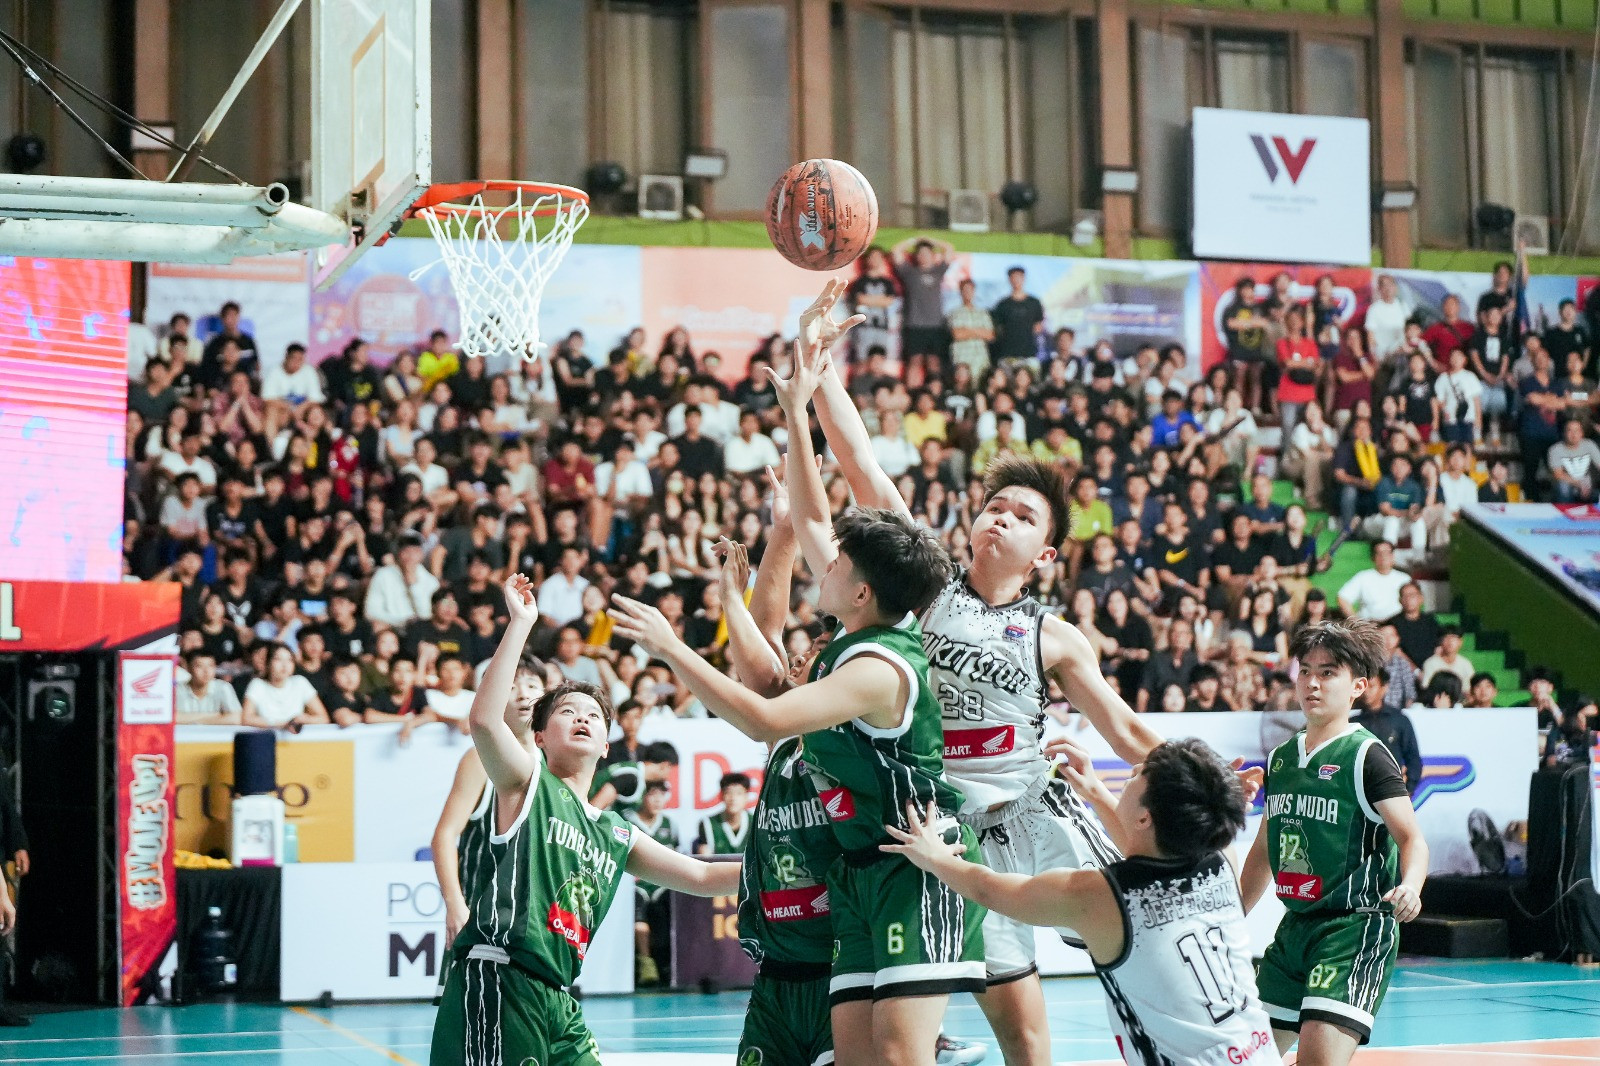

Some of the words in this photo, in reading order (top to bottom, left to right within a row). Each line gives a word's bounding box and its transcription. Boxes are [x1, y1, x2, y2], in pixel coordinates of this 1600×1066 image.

[922, 631, 982, 677] UKIT
[969, 652, 1031, 695] SION
[938, 682, 984, 722] 28
[1295, 794, 1339, 825] MUDA
[773, 905, 803, 919] HEART.
[1143, 881, 1236, 929] JEFFERSON
[887, 921, 905, 955] 6
[1308, 963, 1339, 989] 87
